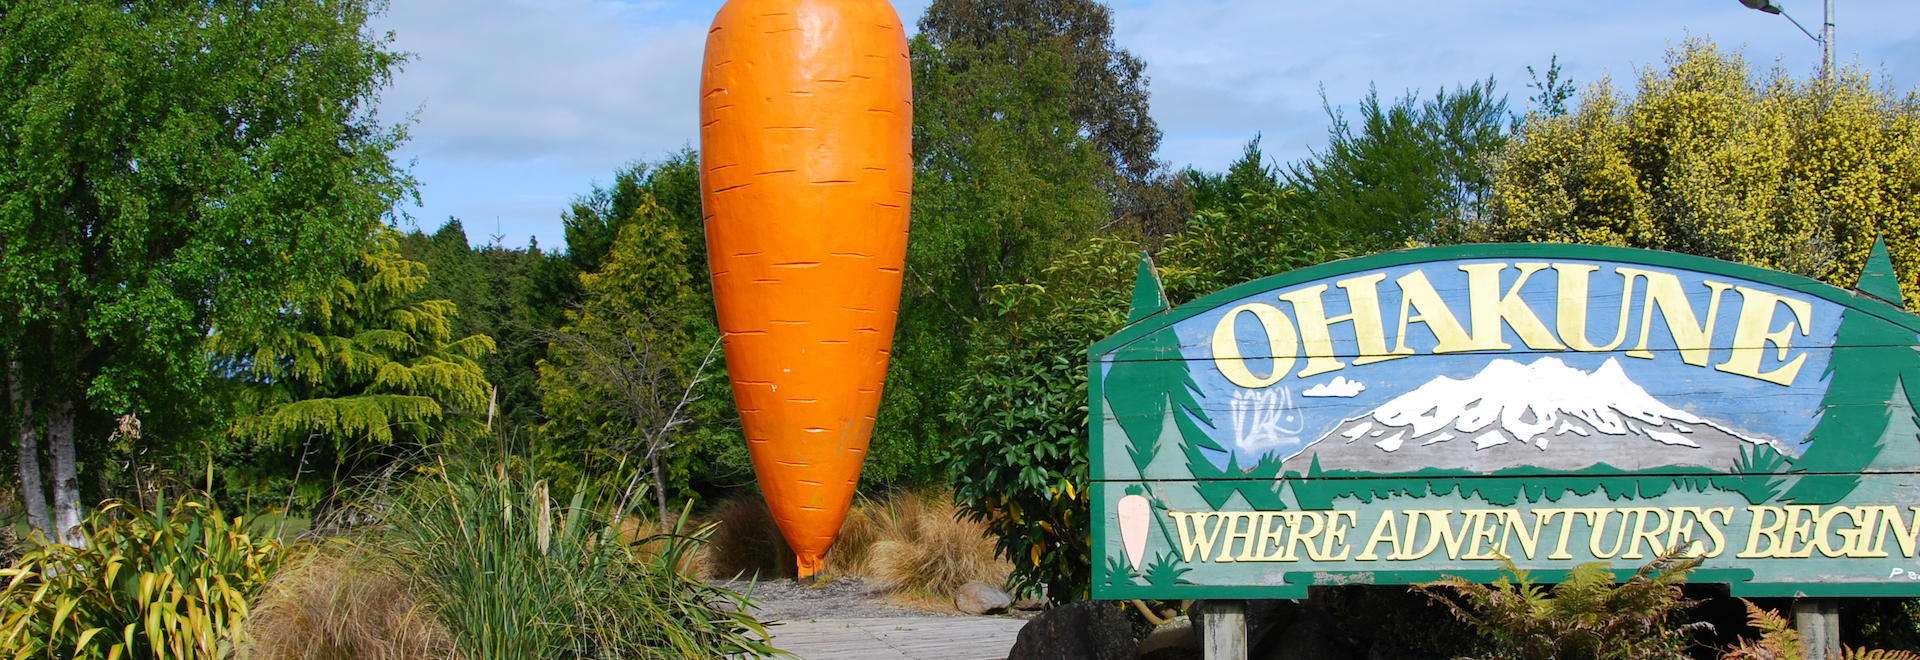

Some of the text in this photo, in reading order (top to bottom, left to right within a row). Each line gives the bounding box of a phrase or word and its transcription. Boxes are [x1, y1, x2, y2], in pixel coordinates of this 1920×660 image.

[1211, 262, 1812, 389] OHAKUNE
[1168, 504, 1920, 562] WHERE ADVENTURES BEGIN
